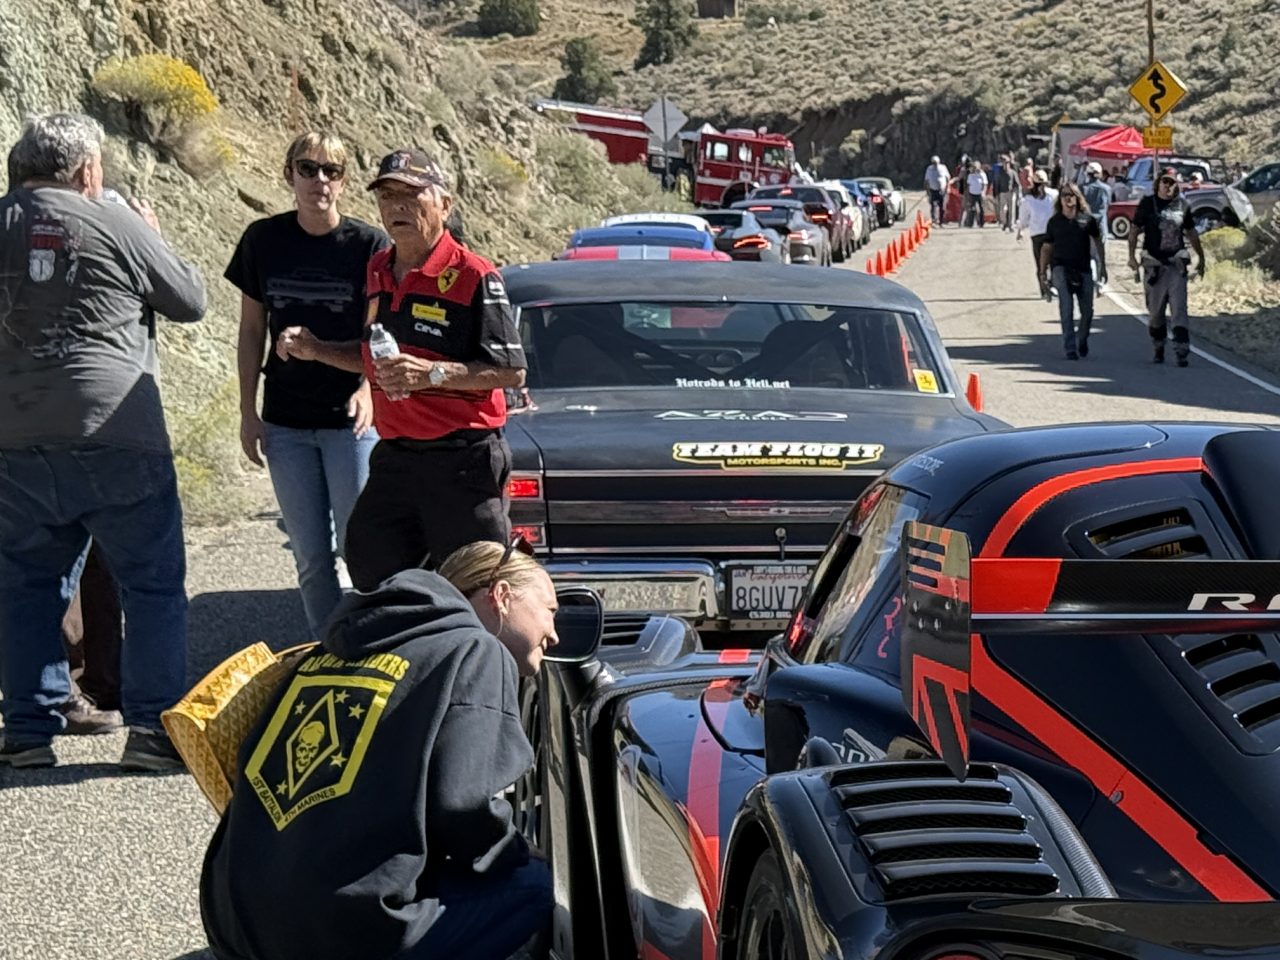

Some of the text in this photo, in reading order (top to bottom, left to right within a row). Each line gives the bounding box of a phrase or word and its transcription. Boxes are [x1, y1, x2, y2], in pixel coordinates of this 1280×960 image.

[675, 378, 725, 388] Hotrods
[728, 379, 741, 388] to
[677, 443, 763, 457] TEAM
[727, 458, 842, 466] MOTORSPORTS INC.
[297, 788, 336, 811] MARINES
